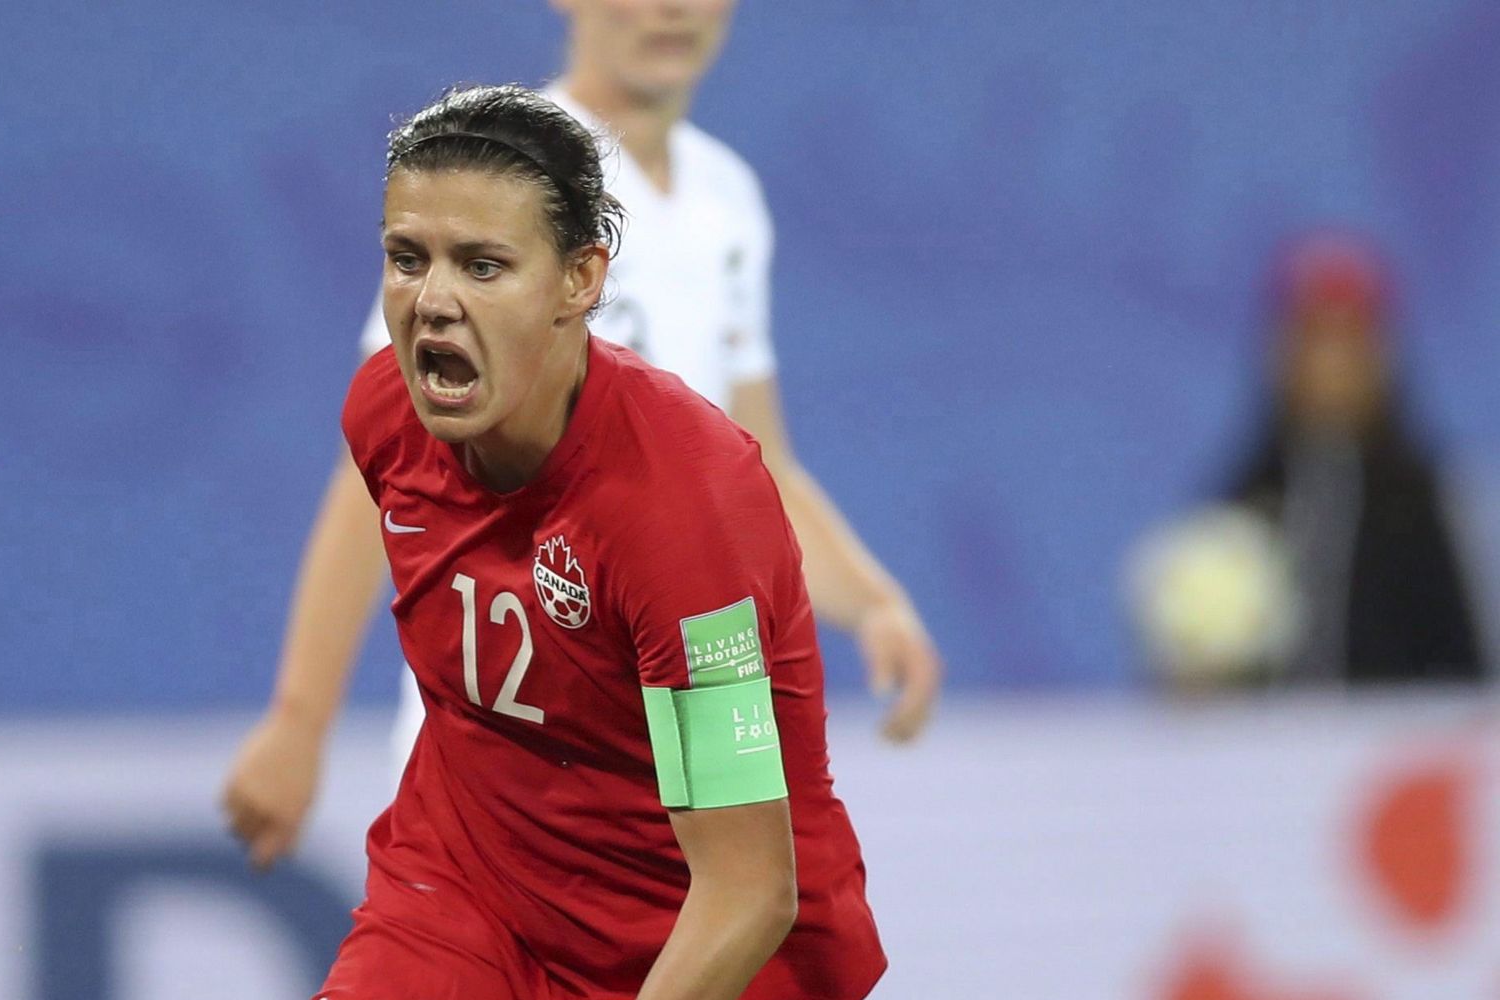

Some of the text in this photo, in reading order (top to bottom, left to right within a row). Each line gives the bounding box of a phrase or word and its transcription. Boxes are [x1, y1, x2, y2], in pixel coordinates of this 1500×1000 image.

[534, 565, 589, 605] CANADA
[451, 572, 545, 725] 12
[693, 628, 755, 655] LIVING
[695, 639, 757, 666] FOOTBALL
[737, 660, 761, 679] FIFA
